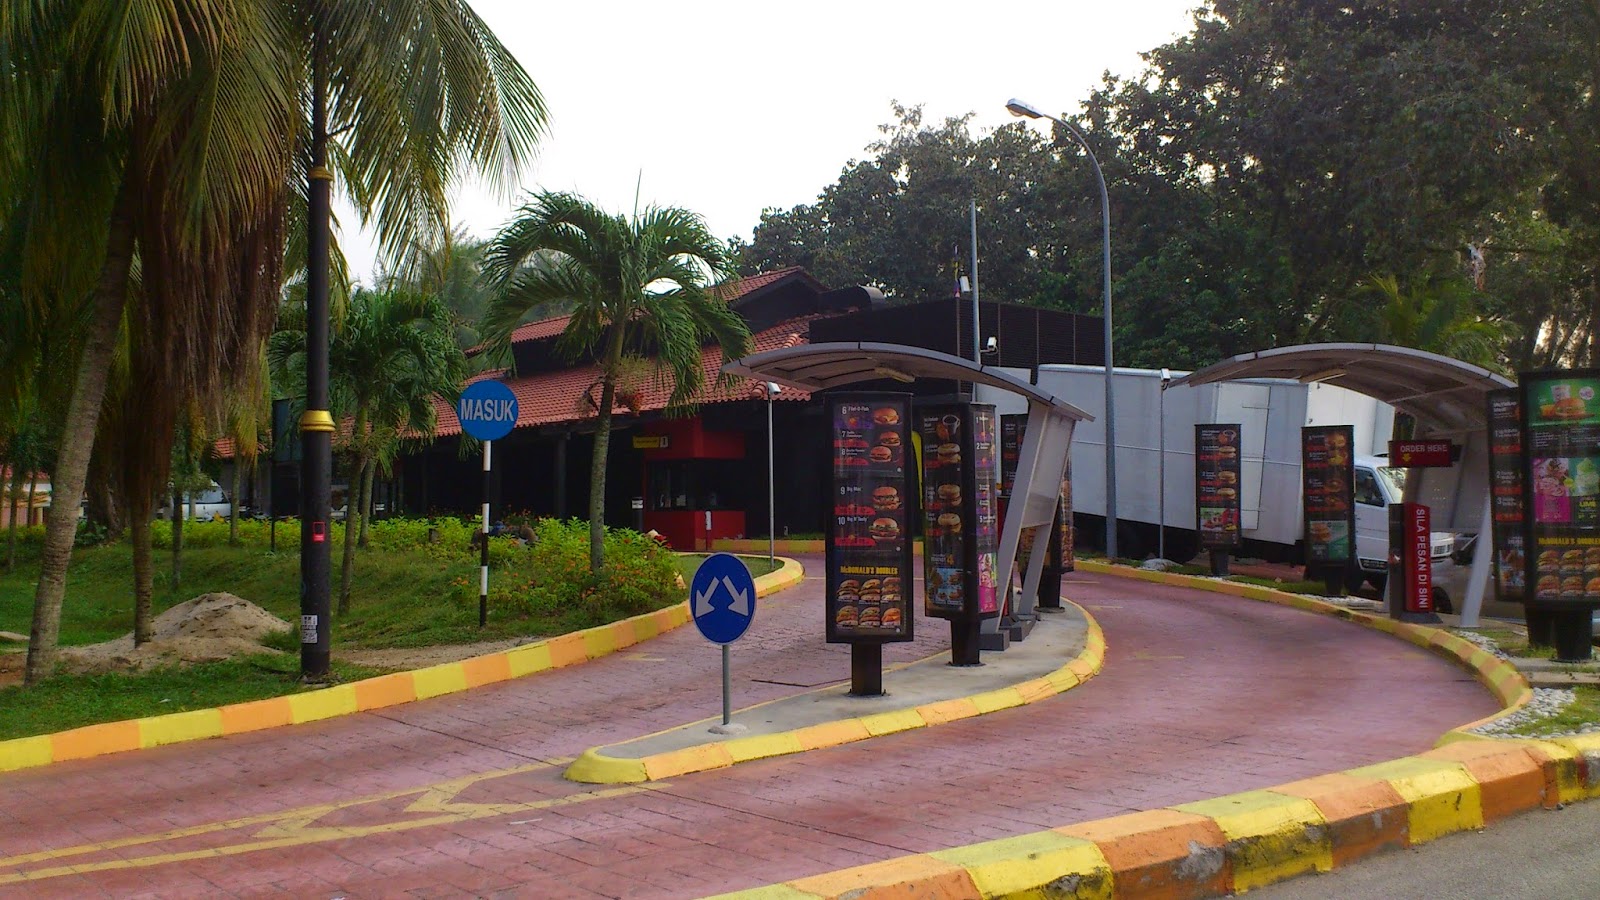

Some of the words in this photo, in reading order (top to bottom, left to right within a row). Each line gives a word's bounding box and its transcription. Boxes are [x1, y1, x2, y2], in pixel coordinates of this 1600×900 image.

[460, 398, 515, 422] MASUK
[841, 406, 847, 415] 6
[841, 430, 846, 438] 7
[1400, 445, 1425, 453] ORDER
[1427, 444, 1448, 452] HERE
[840, 486, 846, 495] 9
[838, 516, 846, 525] 10
[1416, 508, 1426, 533] SILA
[1416, 535, 1427, 572] PESAN
[840, 565, 875, 575] McDONALD'S
[1418, 574, 1427, 585] DI
[1418, 587, 1429, 609] SINI
